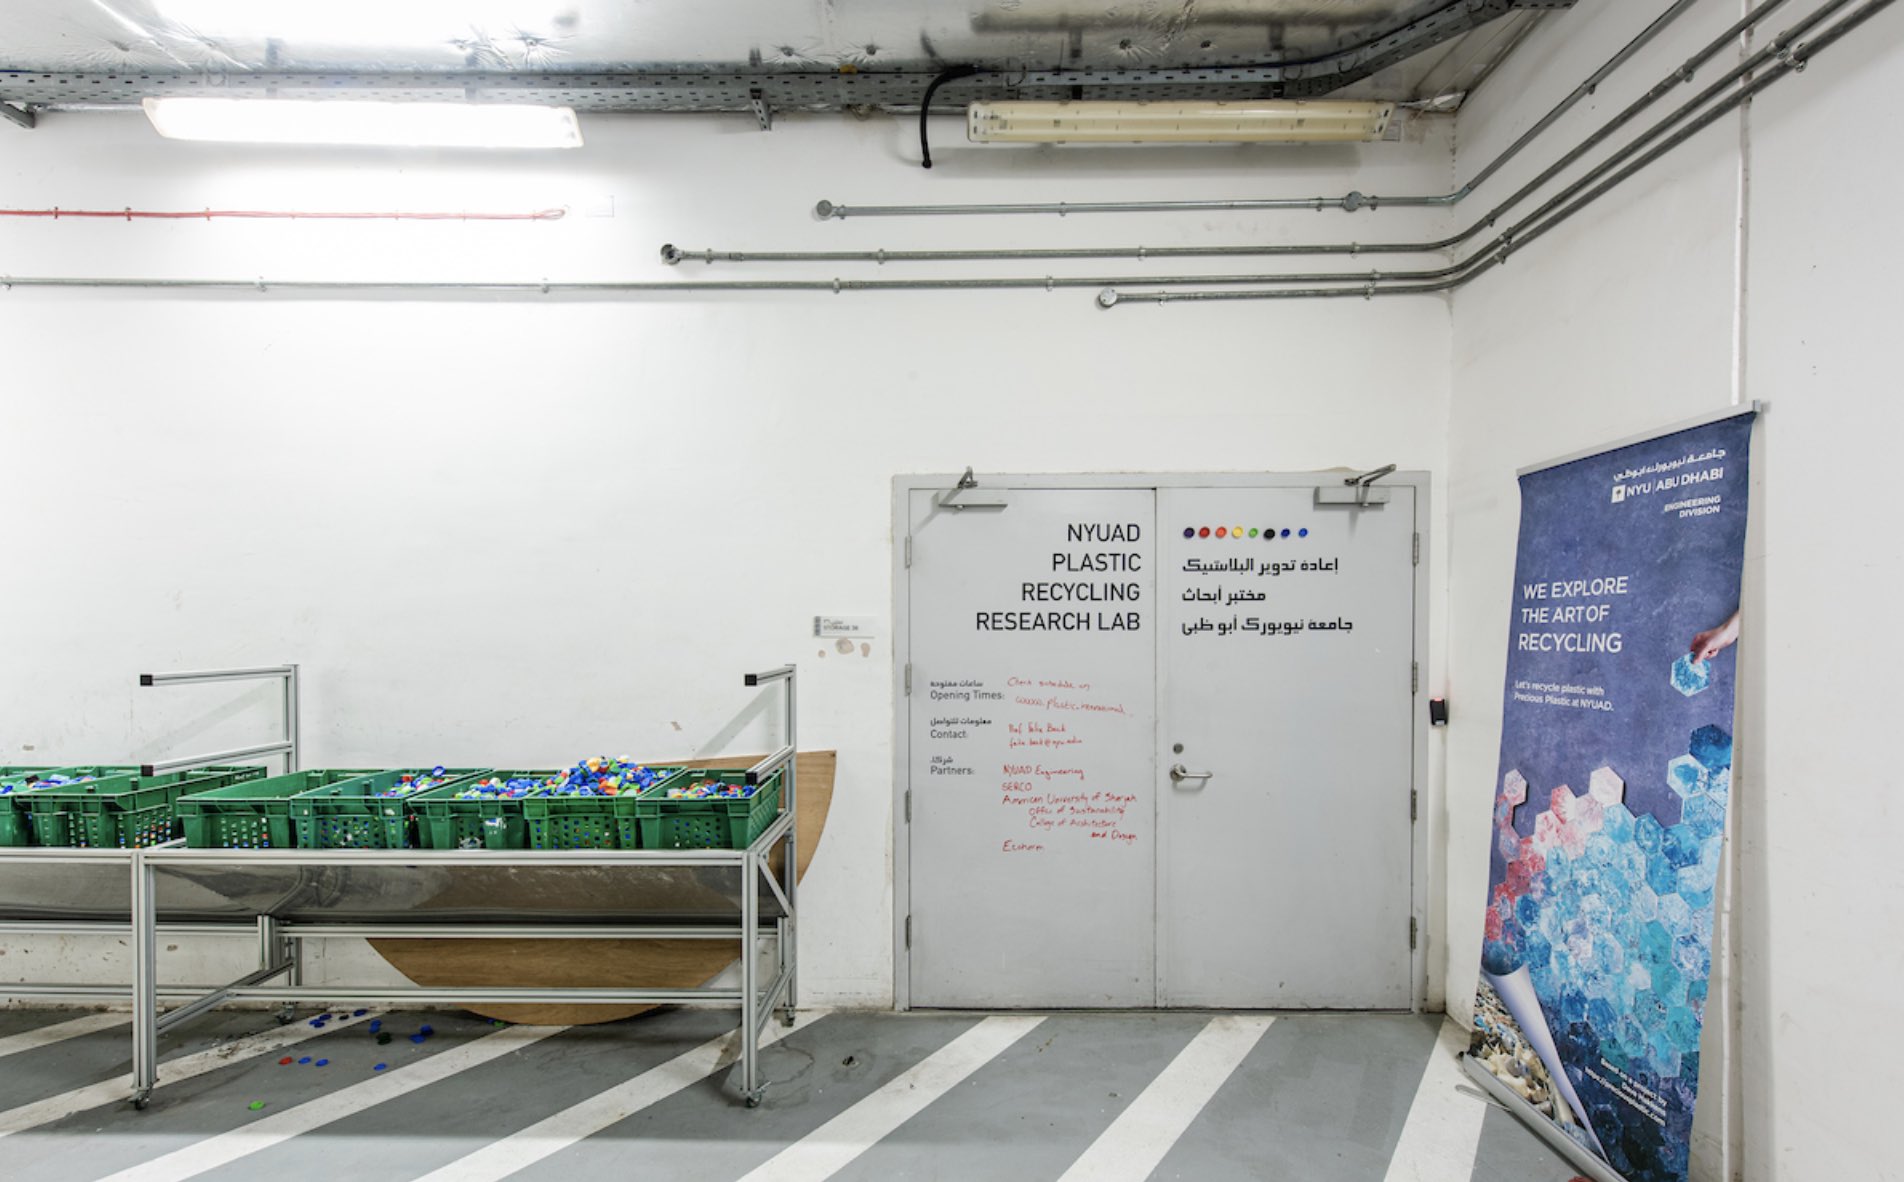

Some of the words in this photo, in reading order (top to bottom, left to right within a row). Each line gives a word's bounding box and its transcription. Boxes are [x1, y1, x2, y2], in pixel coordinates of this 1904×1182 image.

[1626, 482, 1652, 497] NYU
[1655, 475, 1679, 491] ABU
[1681, 467, 1724, 486] DHABI
[1664, 495, 1721, 512] ENGINEERING
[1679, 505, 1720, 518] DIVISION
[1067, 523, 1141, 542] NYUAD
[1052, 553, 1141, 572] PLASTIC
[1257, 559, 1297, 577] تدوير
[1300, 557, 1339, 575] إعادة
[1021, 582, 1141, 601] RECYCLING
[1181, 584, 1222, 605] أبحاث
[1523, 583, 1547, 600] WE
[1551, 576, 1629, 598] EXPLORE
[1225, 589, 1267, 606] مختبر
[976, 612, 1090, 631] RESEARCH
[1098, 612, 1141, 631] LAB
[1521, 607, 1550, 624] THE
[1551, 605, 1585, 624] ART
[1585, 605, 1610, 622] OF
[1217, 613, 1238, 636] أبو
[1308, 617, 1353, 634] جامعة
[1518, 633, 1623, 653] RECYCLING
[930, 689, 970, 702] Opening
[973, 689, 1005, 700] Times:
[1514, 679, 1530, 690] Let's
[1531, 681, 1560, 693] recycle
[1560, 683, 1586, 695] plastic
[1586, 685, 1605, 697] with
[1513, 692, 1544, 704] Precious
[1545, 694, 1571, 707] Plastic
[1571, 698, 1580, 708] at
[1580, 699, 1615, 712] NYUAD.
[930, 764, 977, 777] Partners:
[1003, 764, 1033, 777] NYUAD
[1034, 765, 1085, 781] Engineering
[1002, 781, 1033, 792] SERCO
[1002, 794, 1044, 806] American
[1046, 792, 1089, 808] University
[1091, 792, 1102, 802] of
[1056, 804, 1066, 815] of
[1028, 815, 1055, 832] College
[1057, 817, 1068, 827] of
[1069, 817, 1117, 829] Architecture
